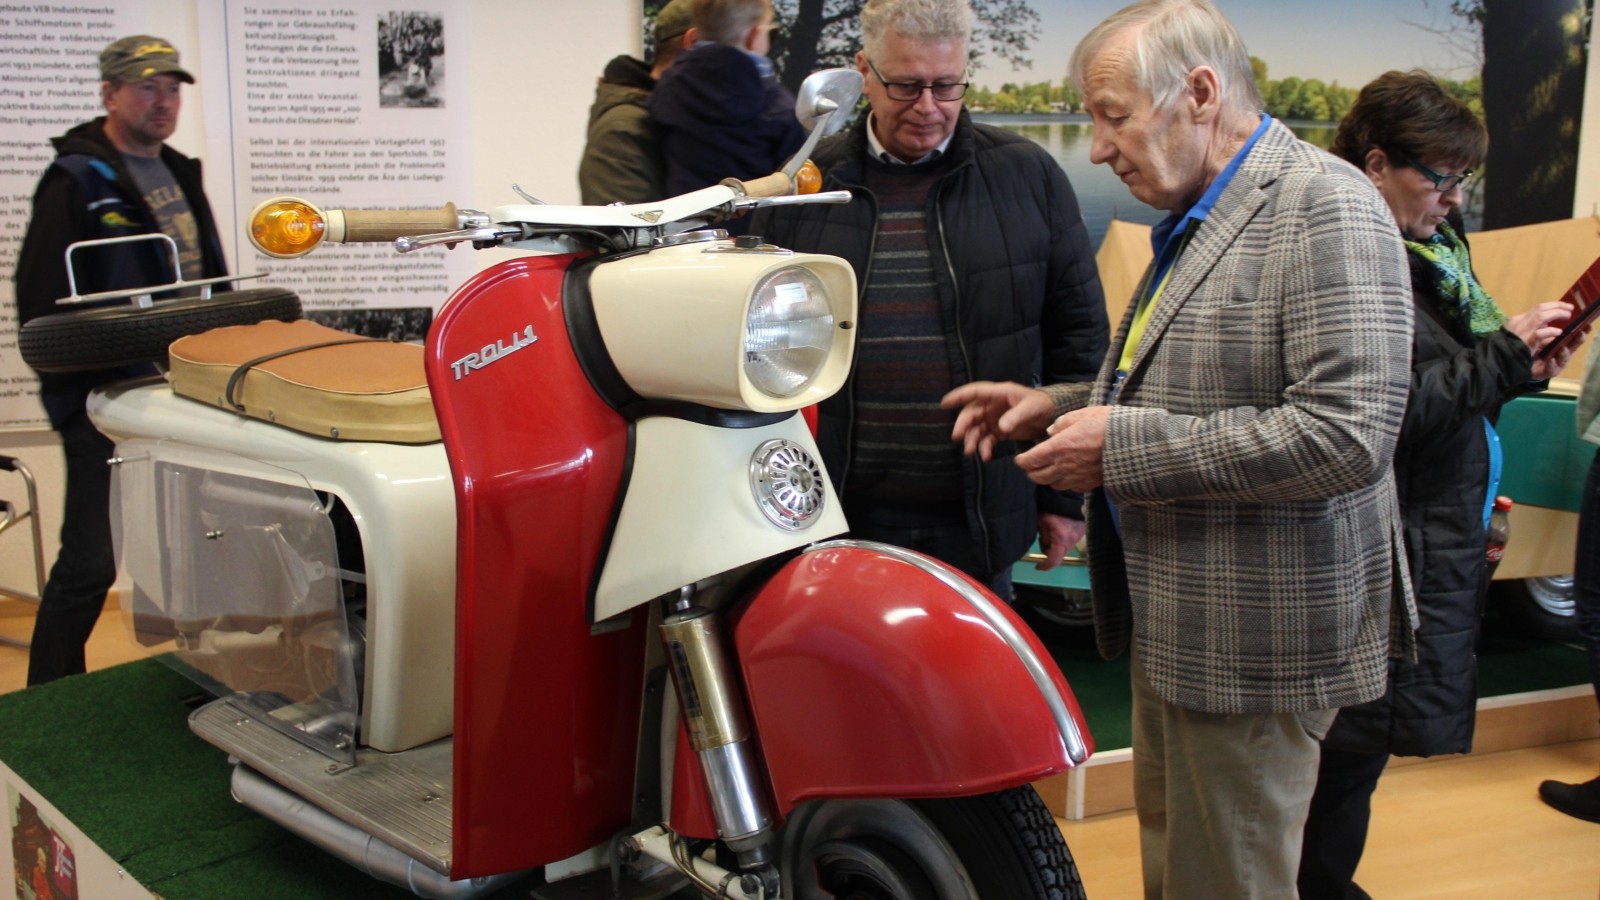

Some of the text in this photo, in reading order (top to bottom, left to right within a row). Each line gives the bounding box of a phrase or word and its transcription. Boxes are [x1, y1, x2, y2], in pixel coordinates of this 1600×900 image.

[15, 19, 82, 27] Schiffsmotoren
[293, 21, 357, 30] Gebrauchsfähig-
[245, 44, 294, 53] Erfahrungen
[287, 58, 339, 66] Verbesserung
[320, 70, 360, 78] dringend
[289, 105, 308, 113] April
[19, 117, 73, 126] Eigenbauten
[375, 139, 425, 147] Viertagefahrt
[250, 163, 311, 171] Betriebsleitung
[354, 163, 380, 171] jedoch
